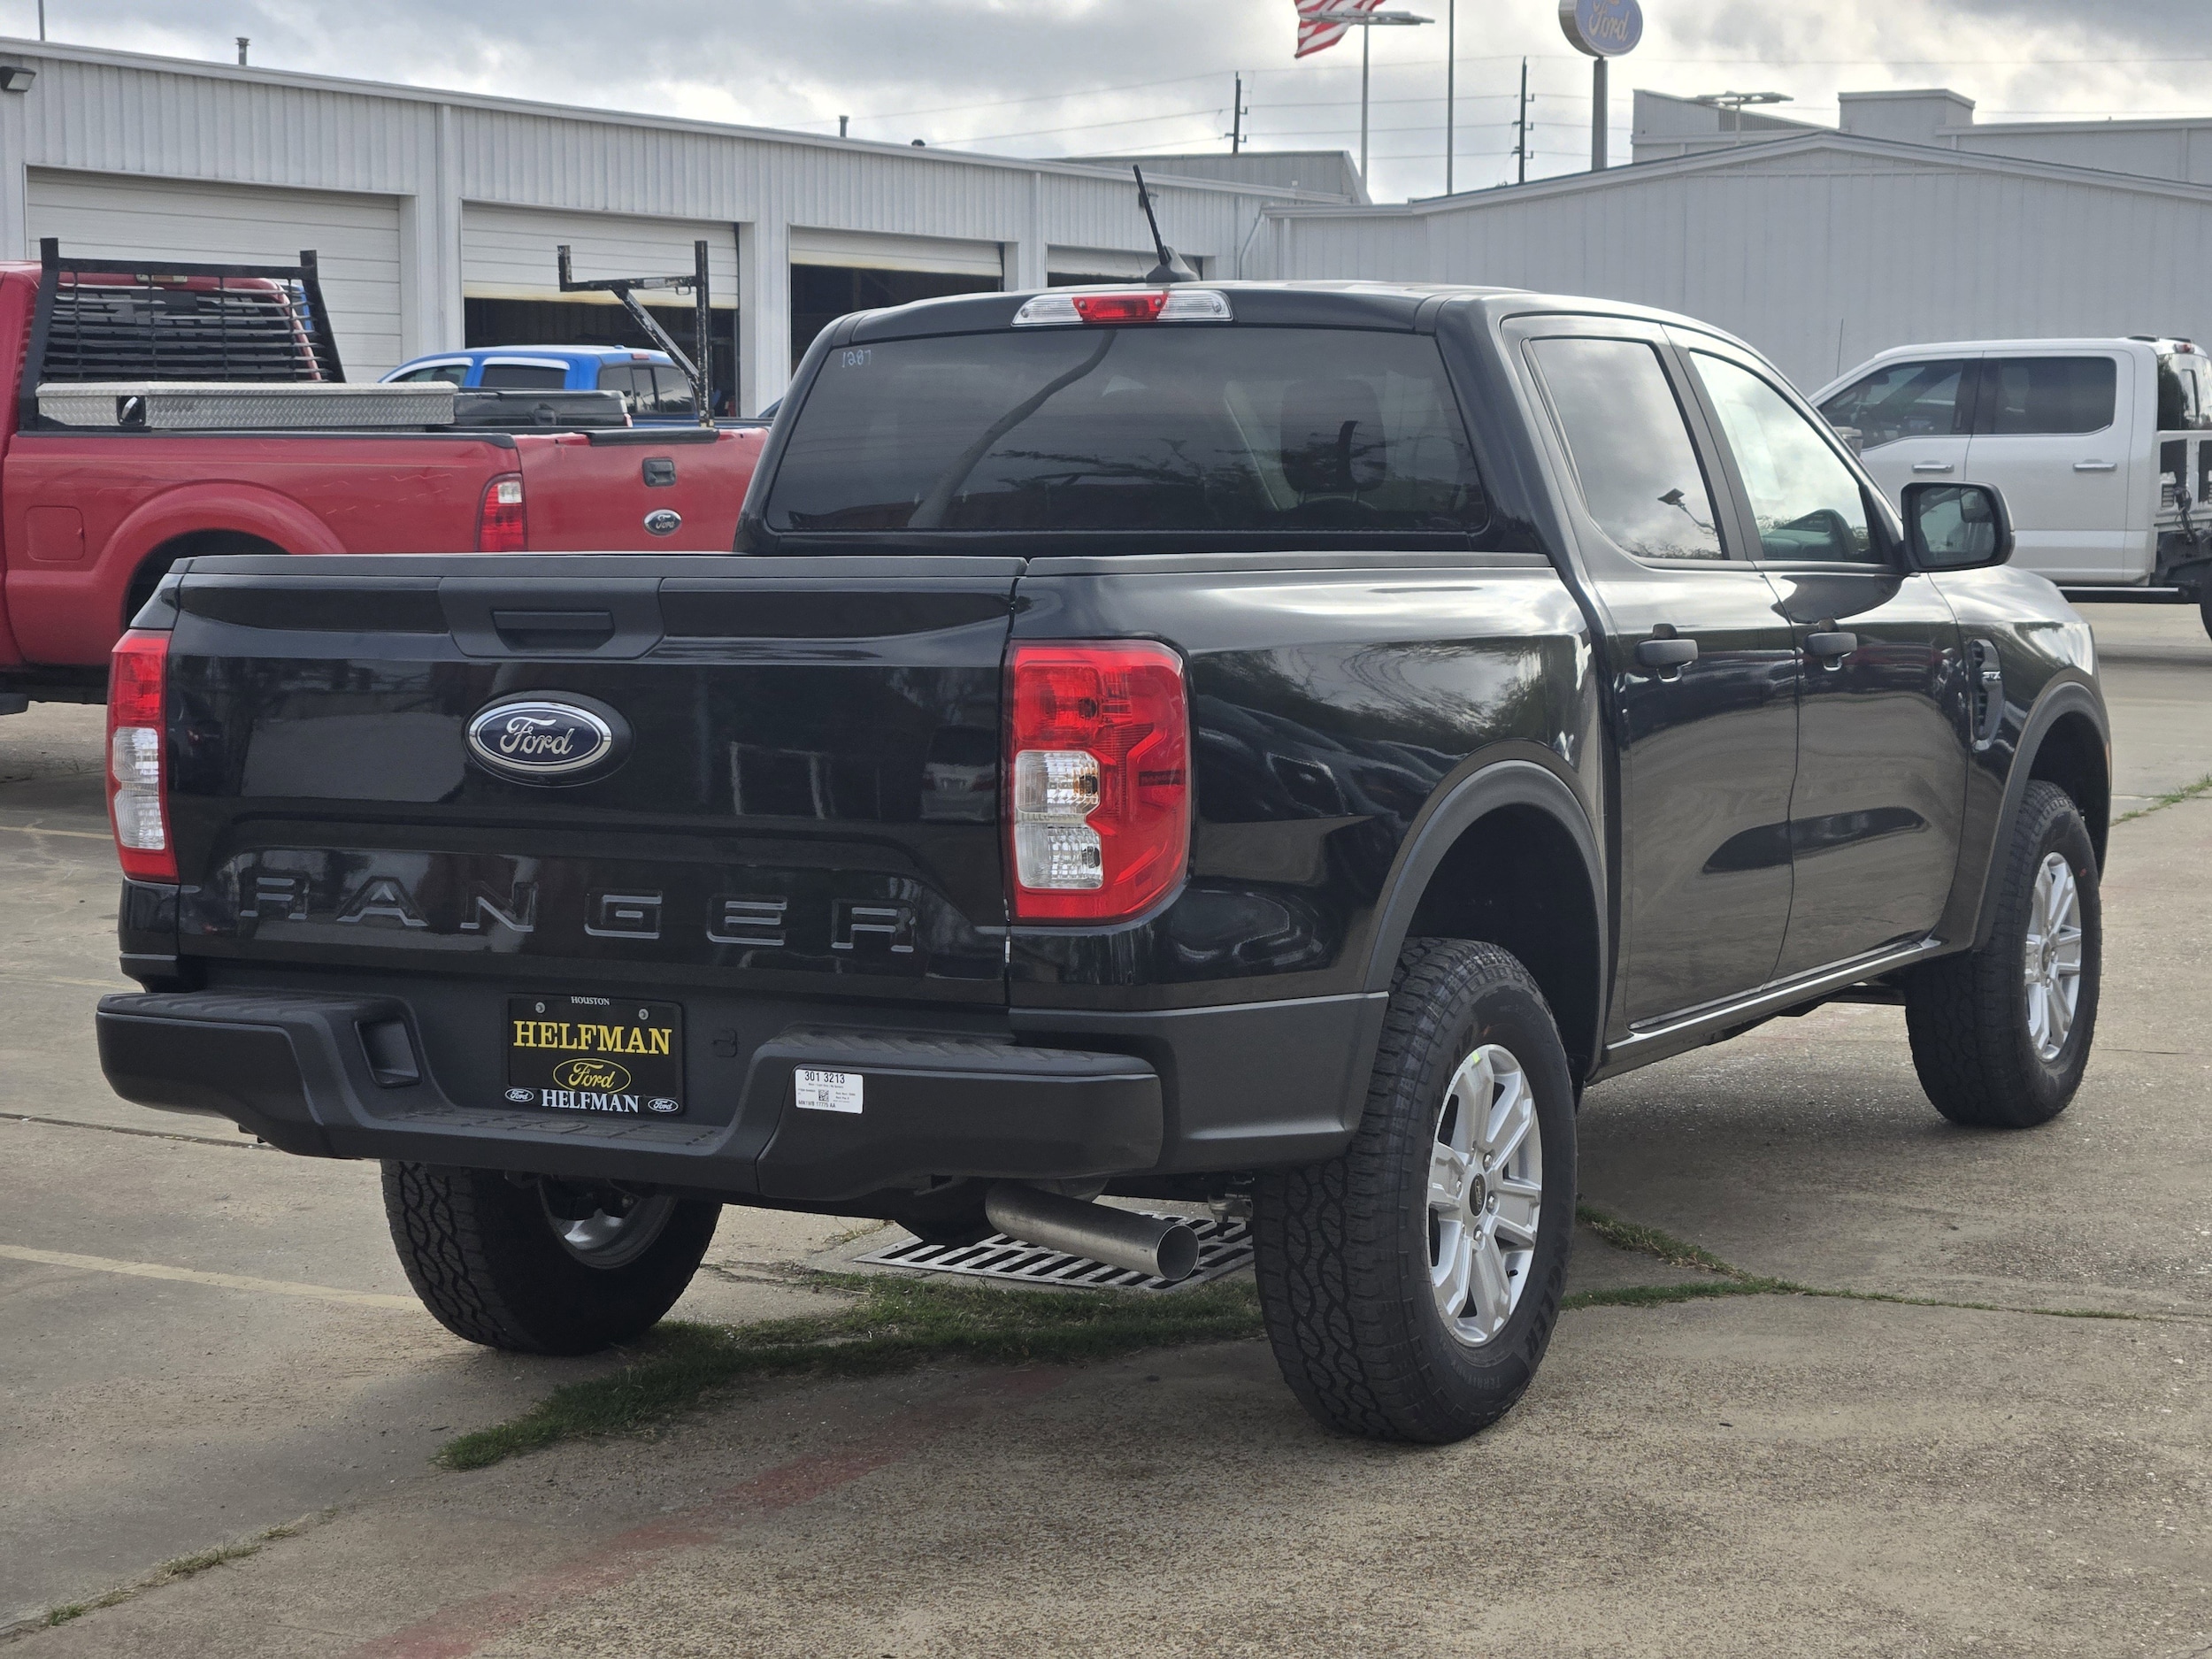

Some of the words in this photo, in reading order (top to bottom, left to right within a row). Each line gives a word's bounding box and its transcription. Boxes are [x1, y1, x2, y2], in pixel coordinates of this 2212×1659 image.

[1588, 0, 1629, 42] Ford
[656, 514, 676, 529] Ford
[499, 716, 575, 755] Ford
[238, 865, 918, 954] RANGER
[571, 995, 611, 1006] HOUSTON
[512, 1020, 672, 1056] HELFMAN
[568, 1062, 616, 1089] Ford
[804, 1071, 820, 1081] 301
[824, 1072, 845, 1084] 3213
[509, 1088, 529, 1100] Ford
[541, 1088, 640, 1113] HELFMAN
[653, 1099, 673, 1110] Ford
